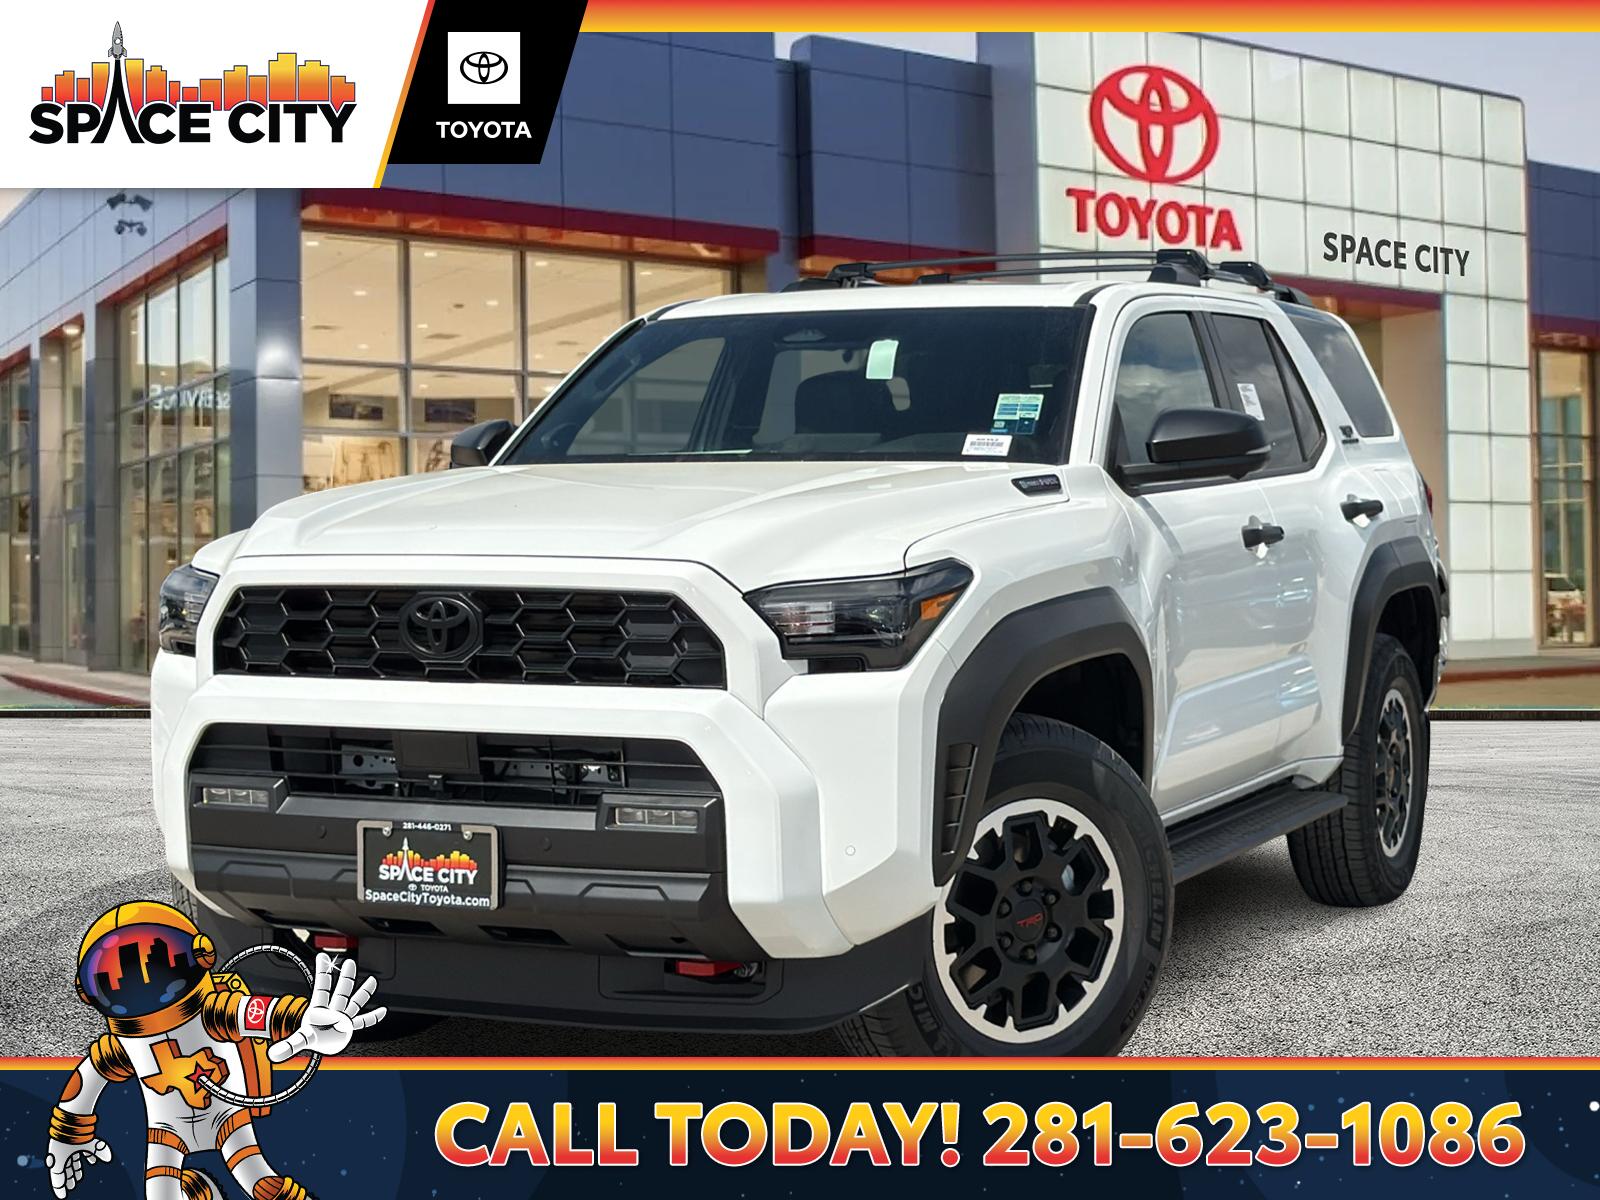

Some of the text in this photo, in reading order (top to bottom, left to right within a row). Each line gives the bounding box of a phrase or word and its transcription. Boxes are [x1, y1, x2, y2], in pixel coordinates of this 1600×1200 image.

[1066, 188, 1242, 251] TOYOTA
[1323, 232, 1470, 277] SPACE CITY
[379, 862, 478, 885] SPACE CITY
[365, 889, 490, 907] SpaceCityToyota.com
[420, 883, 449, 893] TOYOTA
